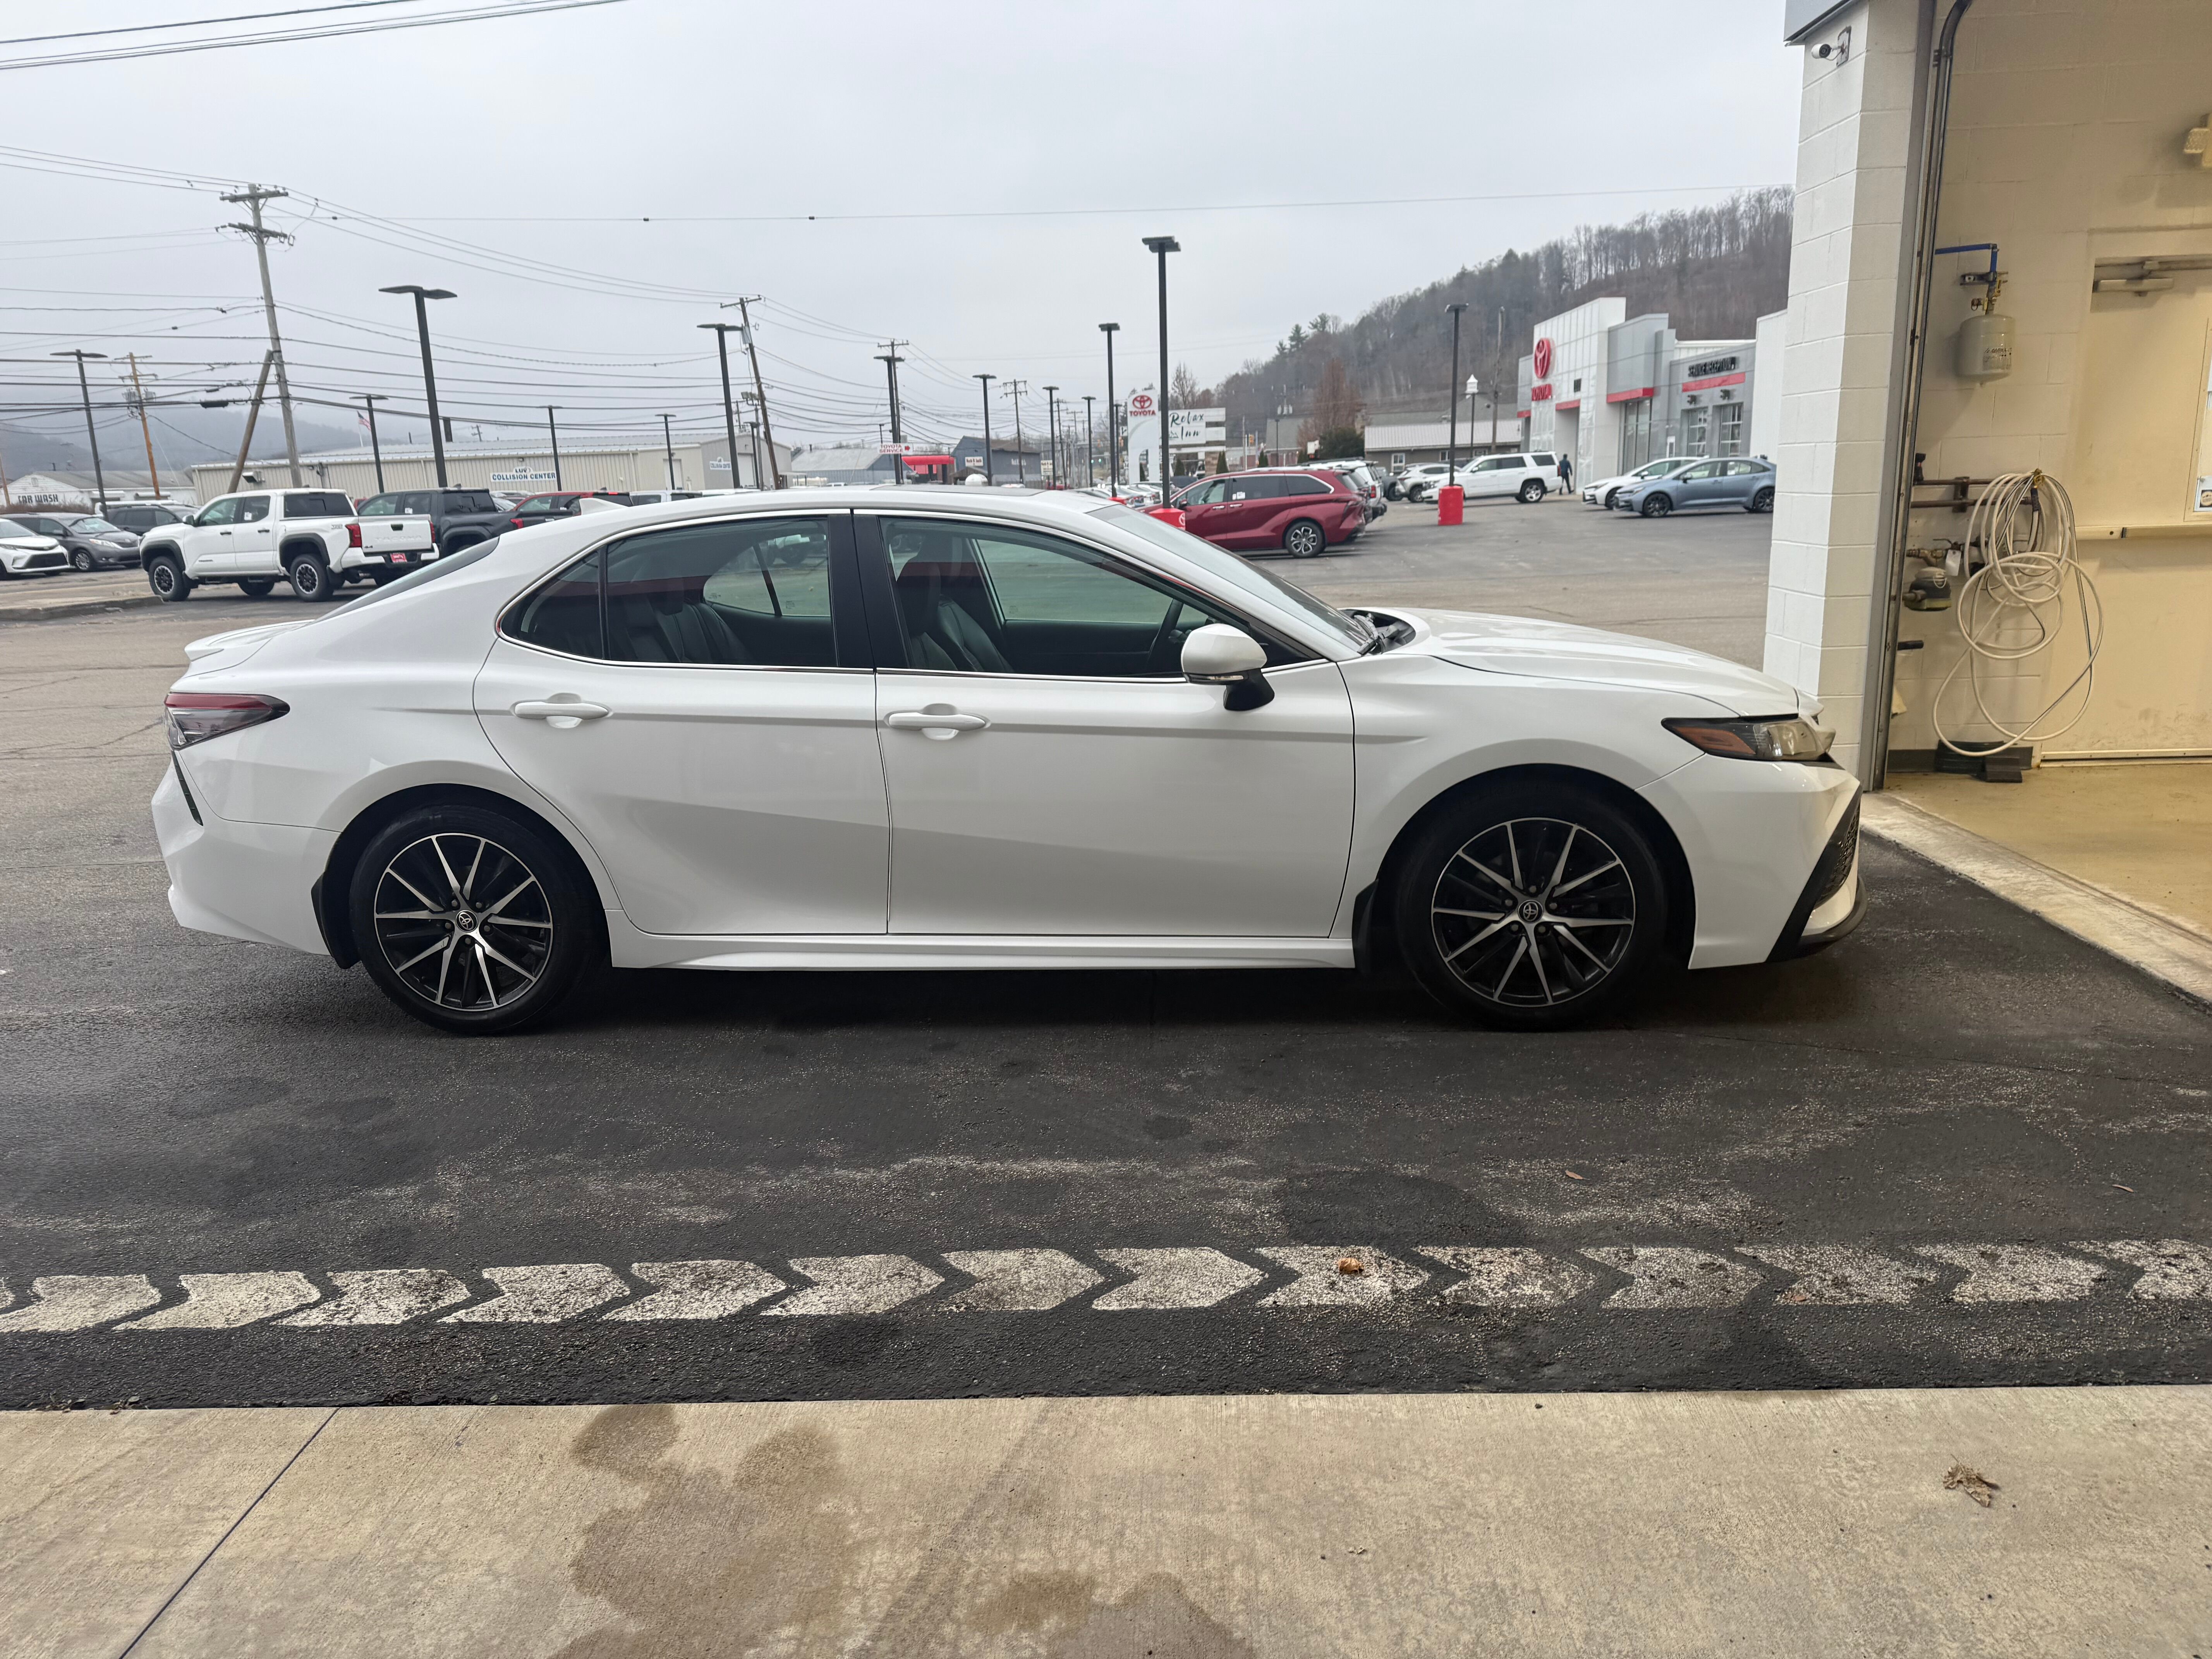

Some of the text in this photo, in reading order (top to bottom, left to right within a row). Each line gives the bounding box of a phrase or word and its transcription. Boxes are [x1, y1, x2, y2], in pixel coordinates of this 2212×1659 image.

[1532, 384, 1552, 401] TOYOTA
[1170, 411, 1204, 427] Relax
[1181, 426, 1200, 440] Inn
[18, 493, 58, 504] CAR WASH
